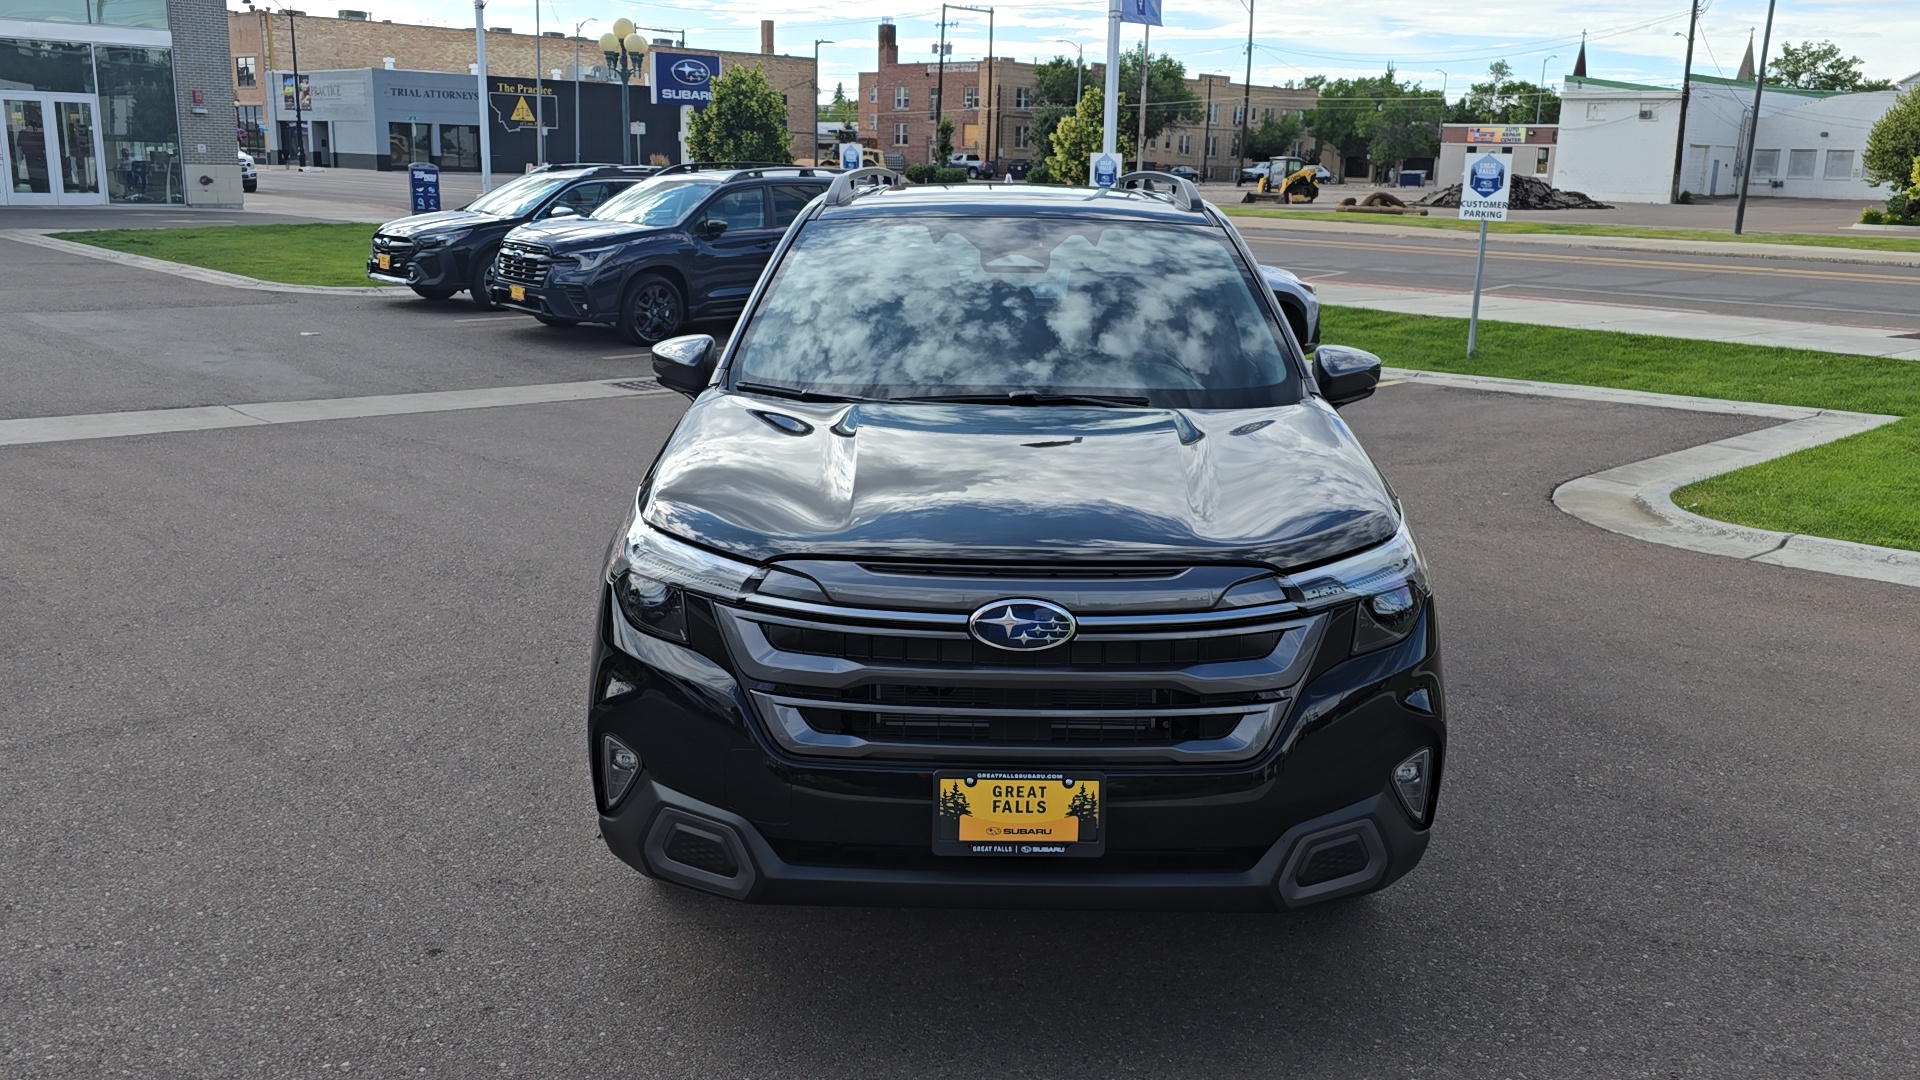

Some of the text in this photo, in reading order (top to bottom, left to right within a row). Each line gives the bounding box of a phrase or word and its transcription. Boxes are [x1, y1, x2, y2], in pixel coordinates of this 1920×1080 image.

[310, 85, 341, 97] PRACTICE
[390, 88, 479, 100] TRIAL ATTORNEYS
[497, 83, 552, 95] The Pracice
[1461, 200, 1509, 209] CUSTOMER
[1463, 209, 1502, 219] PARKING
[992, 785, 1047, 798] GREAT
[992, 799, 1047, 814] FALLS
[972, 845, 992, 853] GREAT
[993, 845, 1013, 853] FALLS
